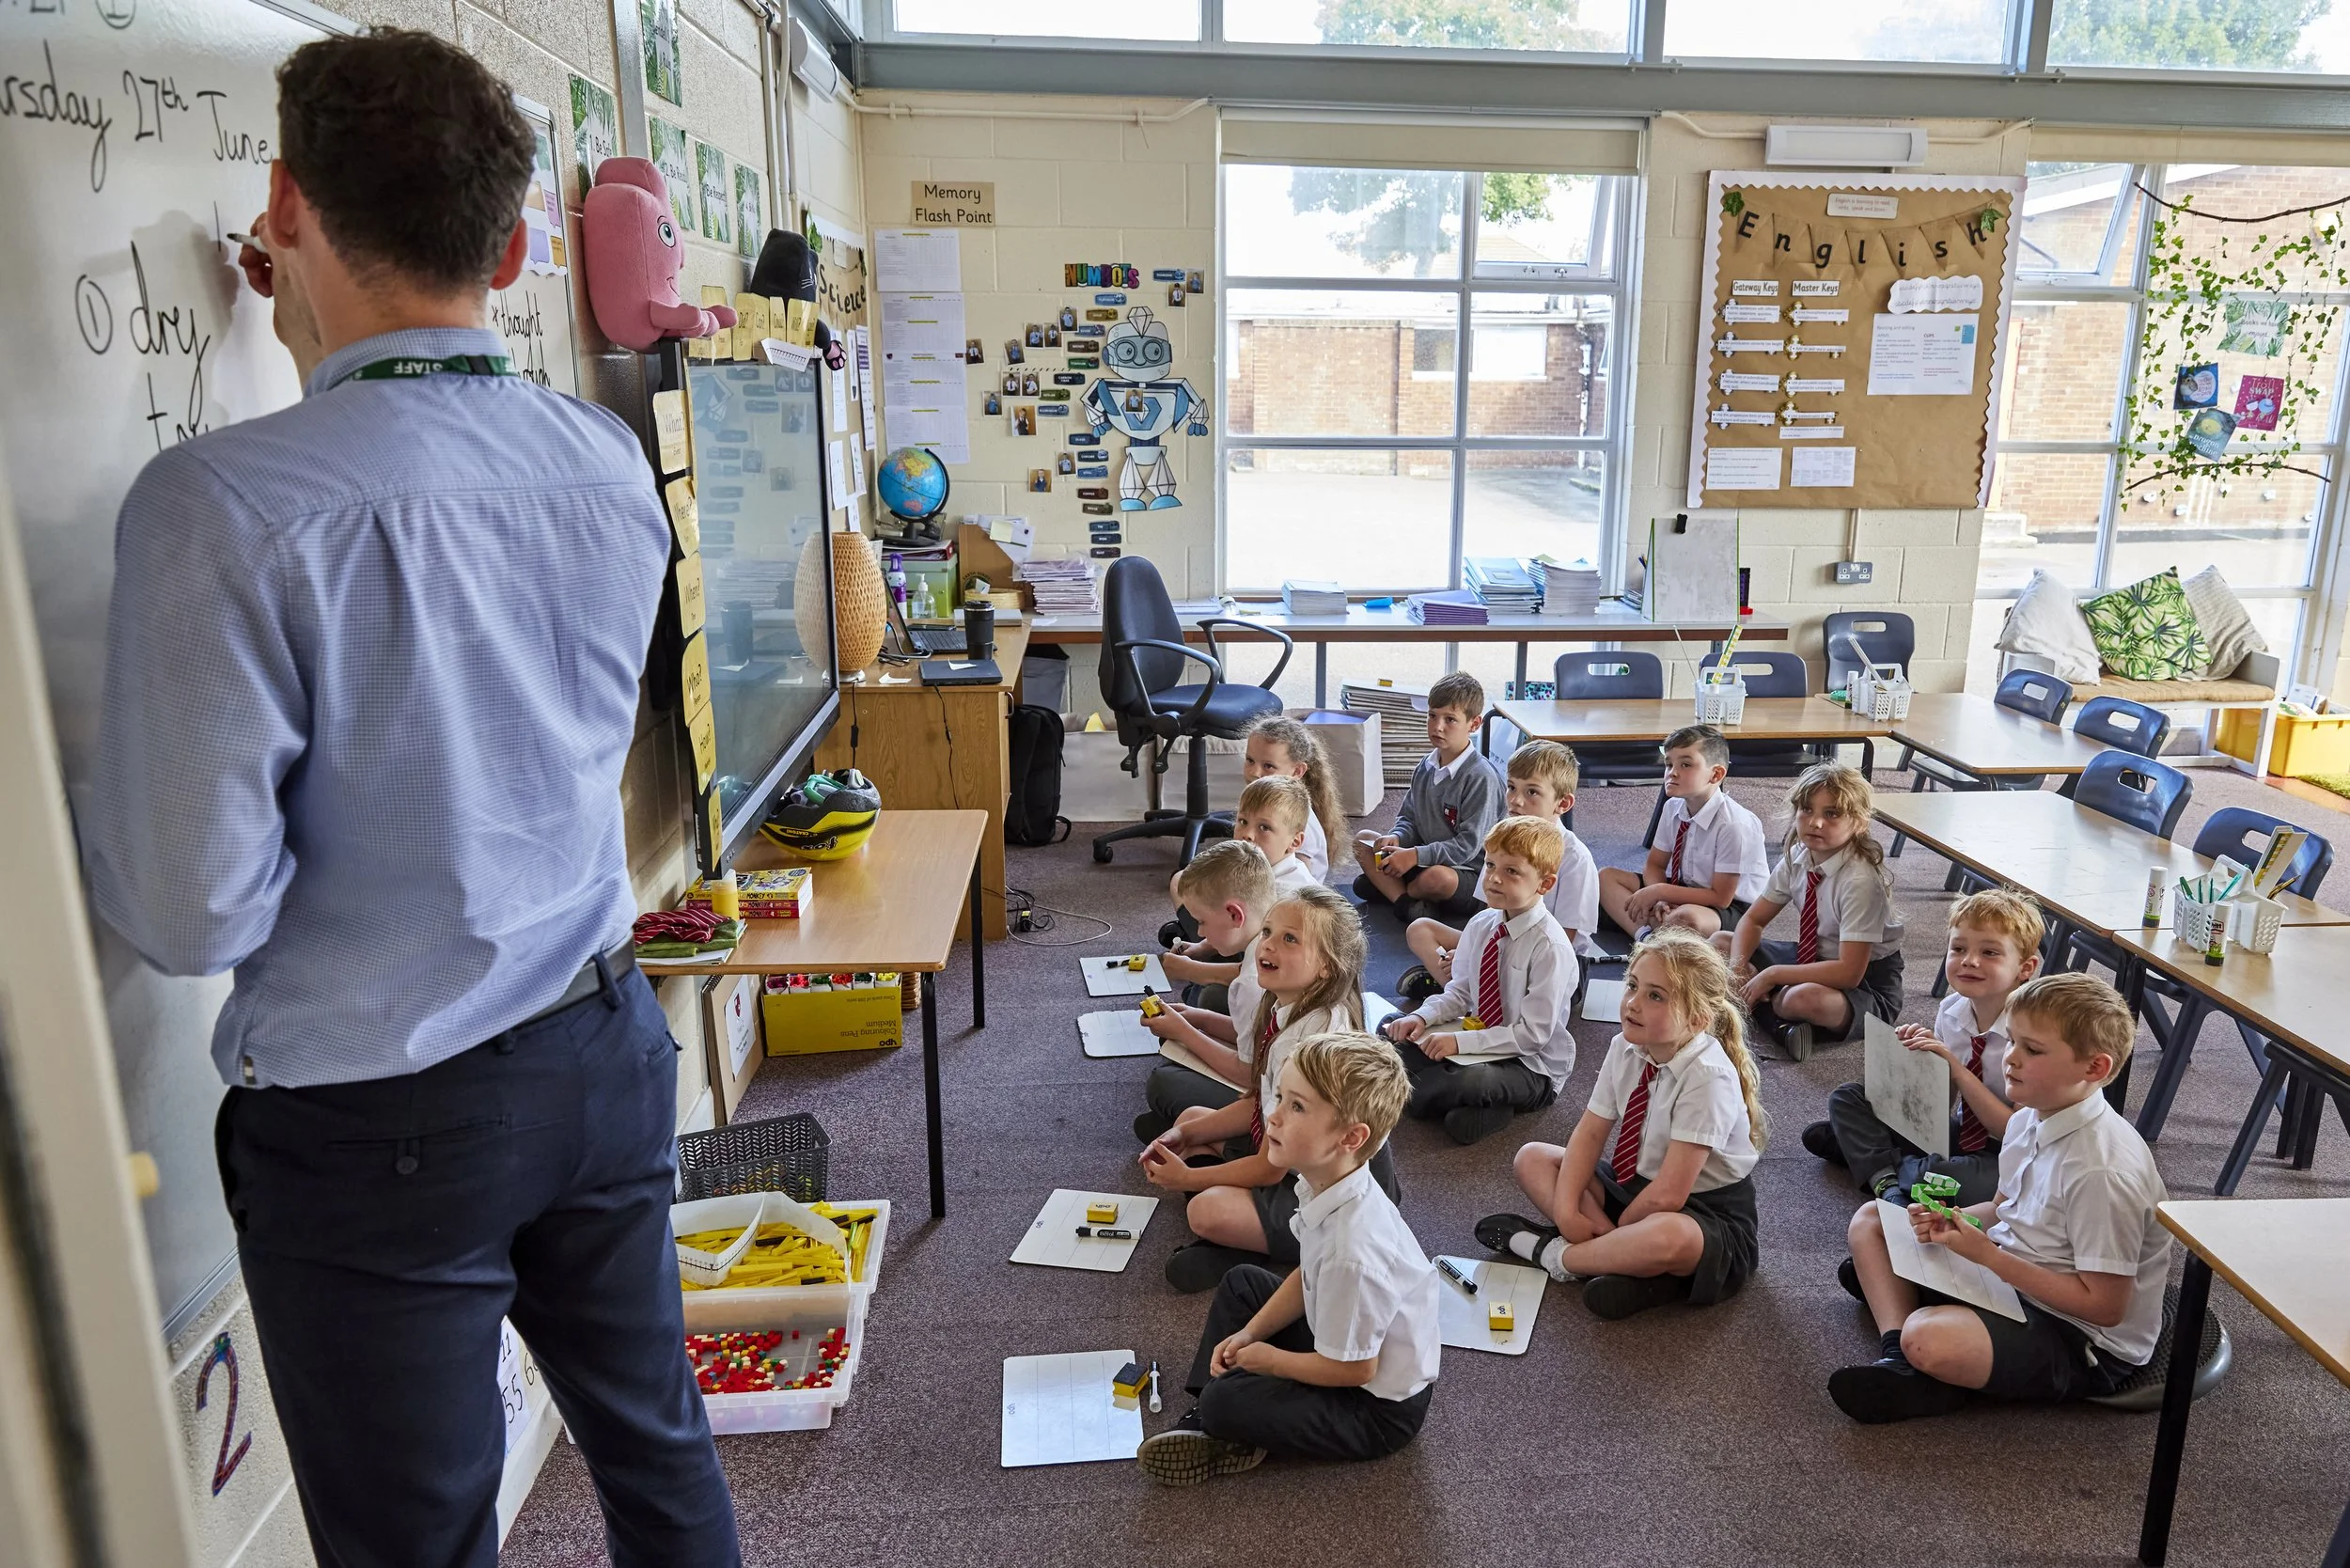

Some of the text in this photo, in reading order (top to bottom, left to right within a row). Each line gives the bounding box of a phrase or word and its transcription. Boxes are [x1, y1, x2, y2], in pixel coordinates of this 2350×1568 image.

[123, 70, 189, 142] 27th
[196, 90, 273, 165] June
[924, 184, 981, 205] Memory
[916, 208, 993, 224] Flash Point
[1739, 210, 1988, 269] English
[819, 263, 867, 314] Science
[1733, 282, 1778, 295] Gateway Keys
[1794, 283, 1839, 295] Master Keys
[130, 240, 211, 431] dry
[394, 360, 444, 374] STAFF
[2249, 386, 2275, 395] SWAP
[2252, 377, 2276, 389] Troll
[663, 411, 685, 434] What?
[2193, 434, 2218, 447] Dragon
[686, 663, 702, 693] Who?
[865, 1019, 897, 1027] Medium
[860, 1027, 897, 1037] Colouring
[879, 1038, 897, 1047] ypo
[1497, 1305, 1506, 1315] ypo
[501, 1372, 523, 1424] 55
[195, 1331, 253, 1498] 2
